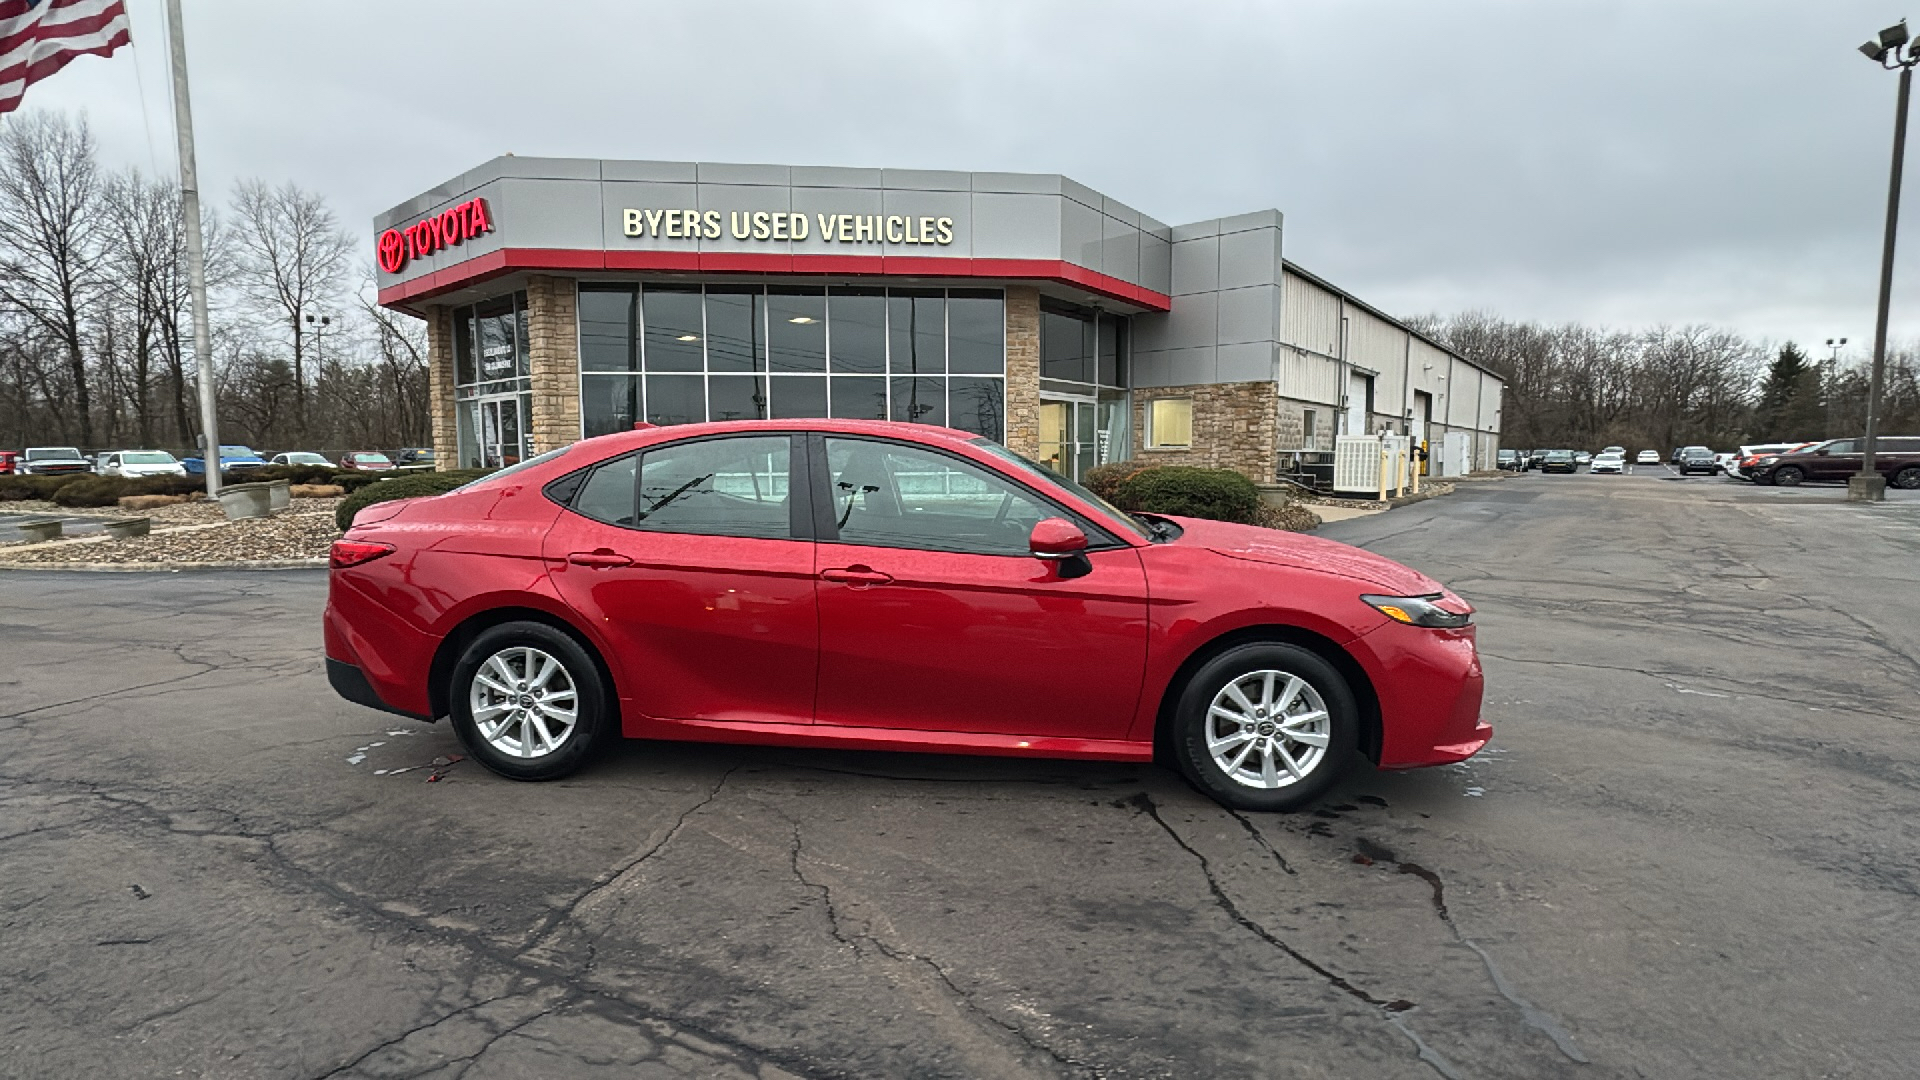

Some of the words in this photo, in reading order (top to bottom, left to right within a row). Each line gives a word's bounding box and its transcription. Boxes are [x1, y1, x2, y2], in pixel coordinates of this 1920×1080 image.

[404, 197, 489, 260] TOYOTA
[623, 208, 721, 239] BYERS
[731, 211, 809, 240] USED
[817, 213, 953, 244] VEHICLES
